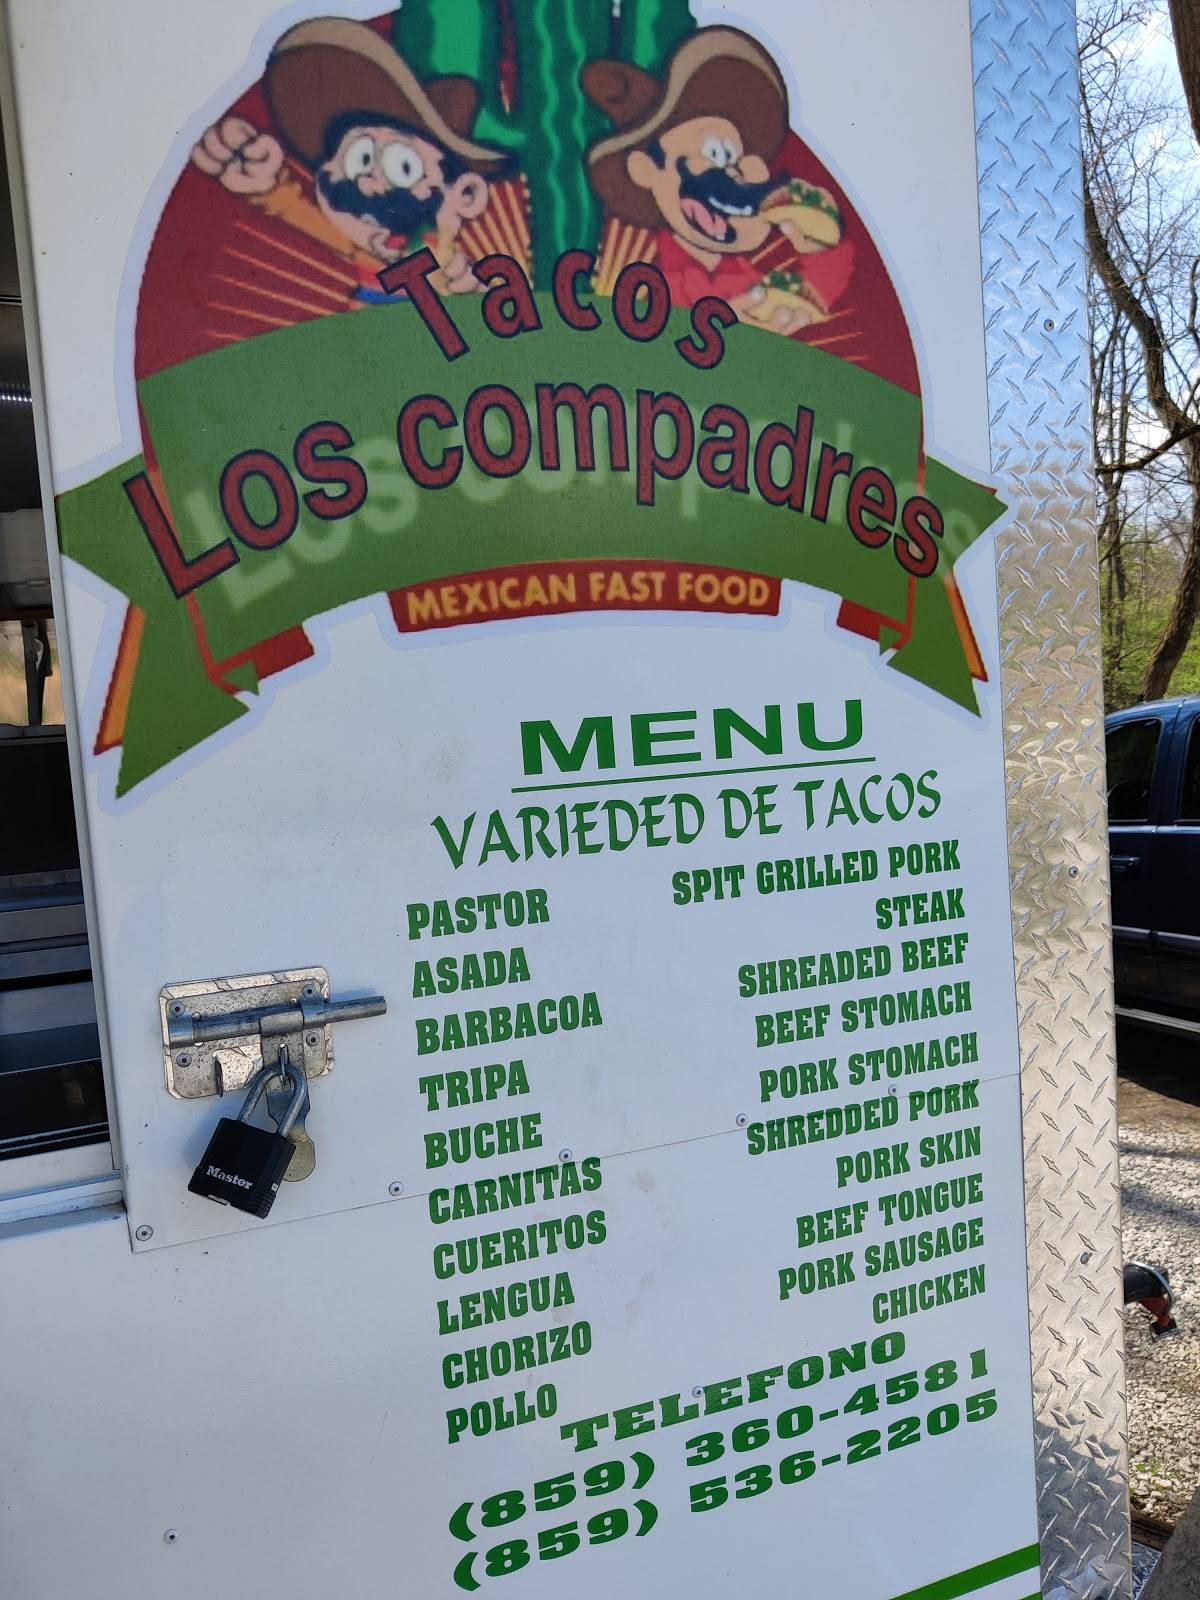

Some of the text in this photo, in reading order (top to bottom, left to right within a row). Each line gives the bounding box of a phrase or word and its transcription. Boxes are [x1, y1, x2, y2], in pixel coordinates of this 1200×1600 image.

[376, 247, 738, 369] Tacos
[122, 381, 945, 599] Los compadres
[406, 571, 771, 624] MEXICAN FAST FOOD
[520, 699, 864, 776] MENU
[430, 769, 942, 870] VARIEDED DE TACOS
[672, 840, 961, 906] SPIT GRILLED PORK
[406, 888, 549, 940] PASTOR
[876, 888, 966, 930] STEAK
[412, 947, 531, 999] ASADA
[738, 932, 969, 998] SHREADED BEEF
[416, 992, 603, 1056] BARBACOA
[756, 980, 973, 1048] BEEF STOMACH
[419, 1060, 530, 1112] TRIPA
[761, 1032, 979, 1103] PORK STOMACH
[424, 1113, 543, 1169] BUCHE
[747, 1080, 980, 1156] SHREDDED PORK
[205, 1165, 254, 1190] Master
[429, 1156, 603, 1225] CARNITAS
[836, 1126, 982, 1188] PORK SKIN
[797, 1172, 985, 1248] BEEF TONGUE
[433, 1210, 608, 1280] CUERITOS
[779, 1217, 984, 1301] PORK SAUSAGE
[437, 1272, 576, 1336] LENGUA
[872, 1264, 987, 1325] CHICKEN
[442, 1320, 592, 1390] CHORIZO
[446, 1382, 558, 1444] POLLO
[559, 1331, 906, 1453] TELEFONO
[448, 1350, 988, 1542] (859) 360-4581
[453, 1391, 999, 1592] (859) 536-2205
